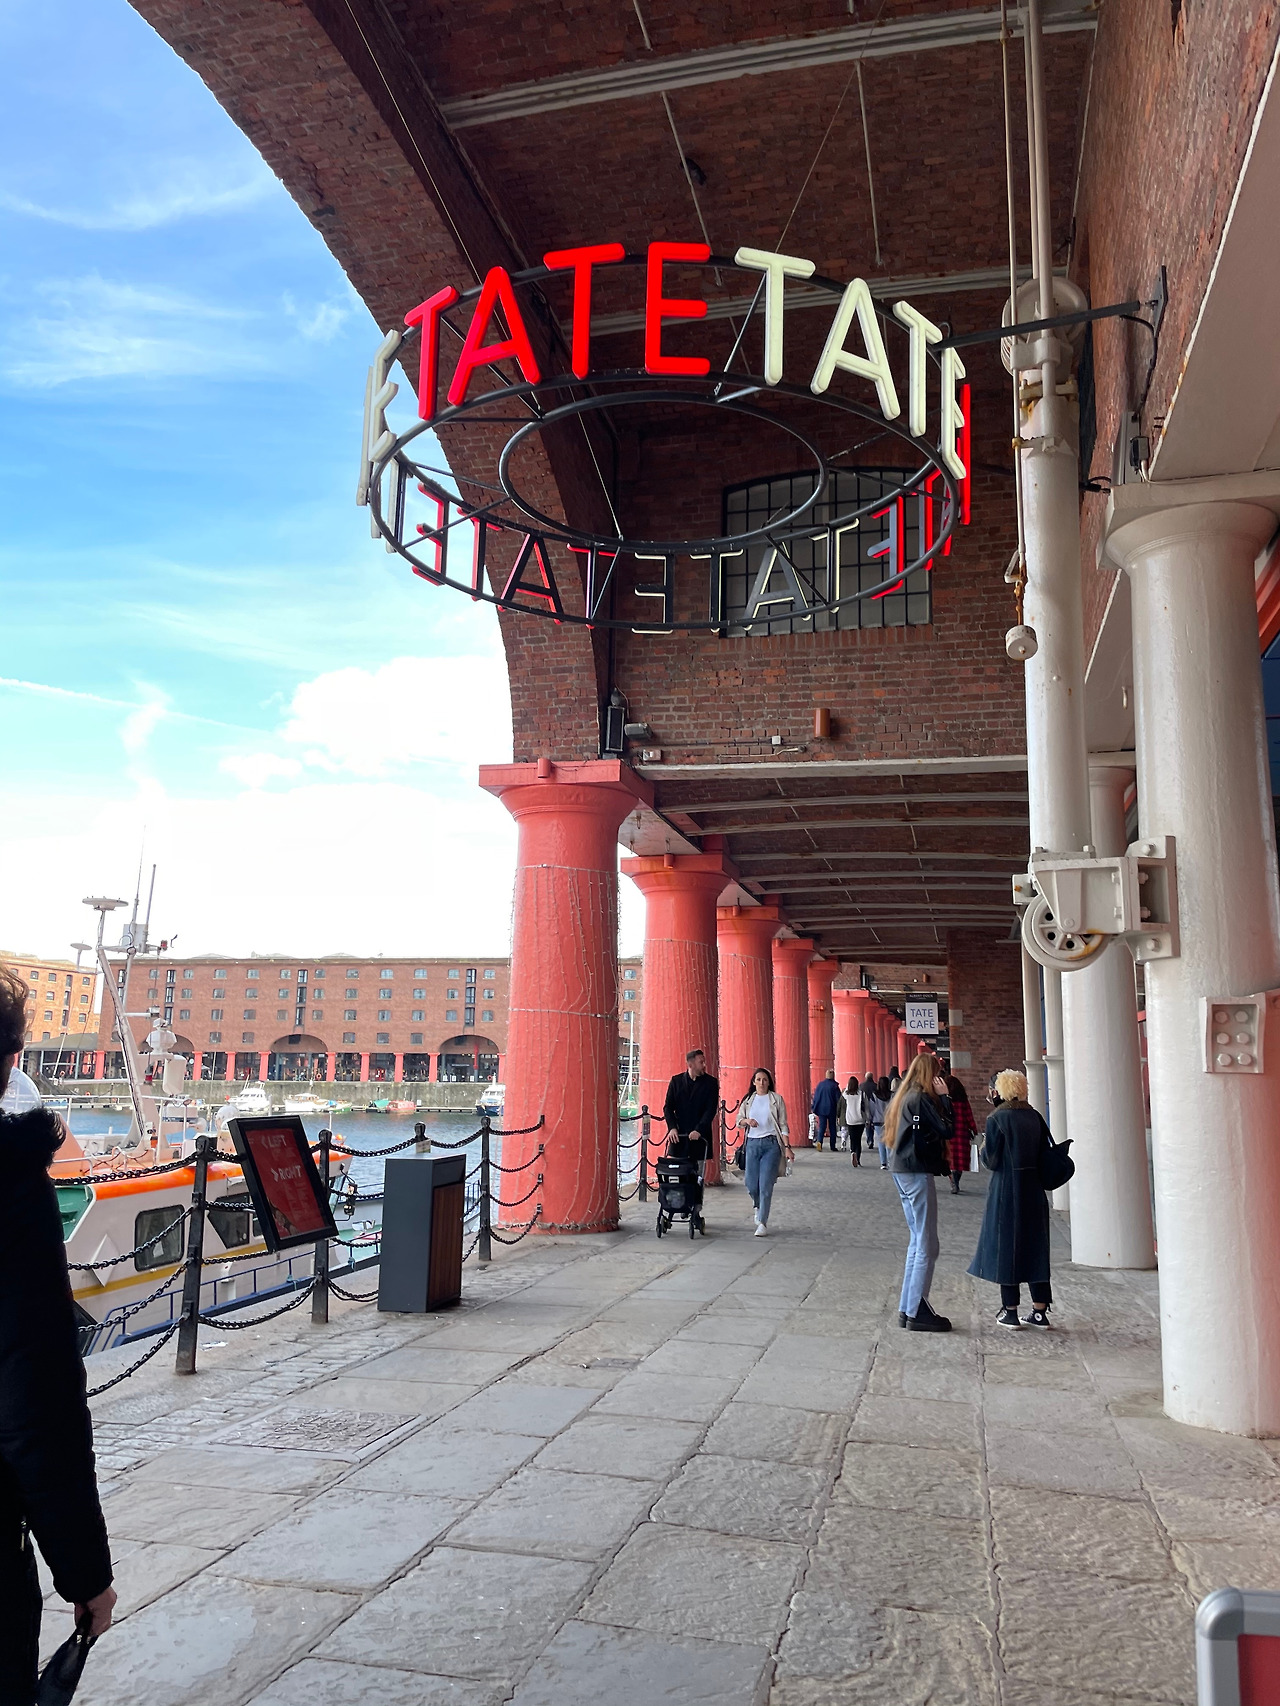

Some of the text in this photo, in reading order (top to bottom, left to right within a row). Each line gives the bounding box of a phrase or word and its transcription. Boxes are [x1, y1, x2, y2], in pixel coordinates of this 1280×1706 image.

[404, 242, 966, 479] TATE TATE
[910, 1008, 934, 1017] TATE
[909, 1018, 935, 1028] CAFÉ
[267, 1134, 287, 1147] LEFT
[278, 1165, 302, 1180] RIGHT
